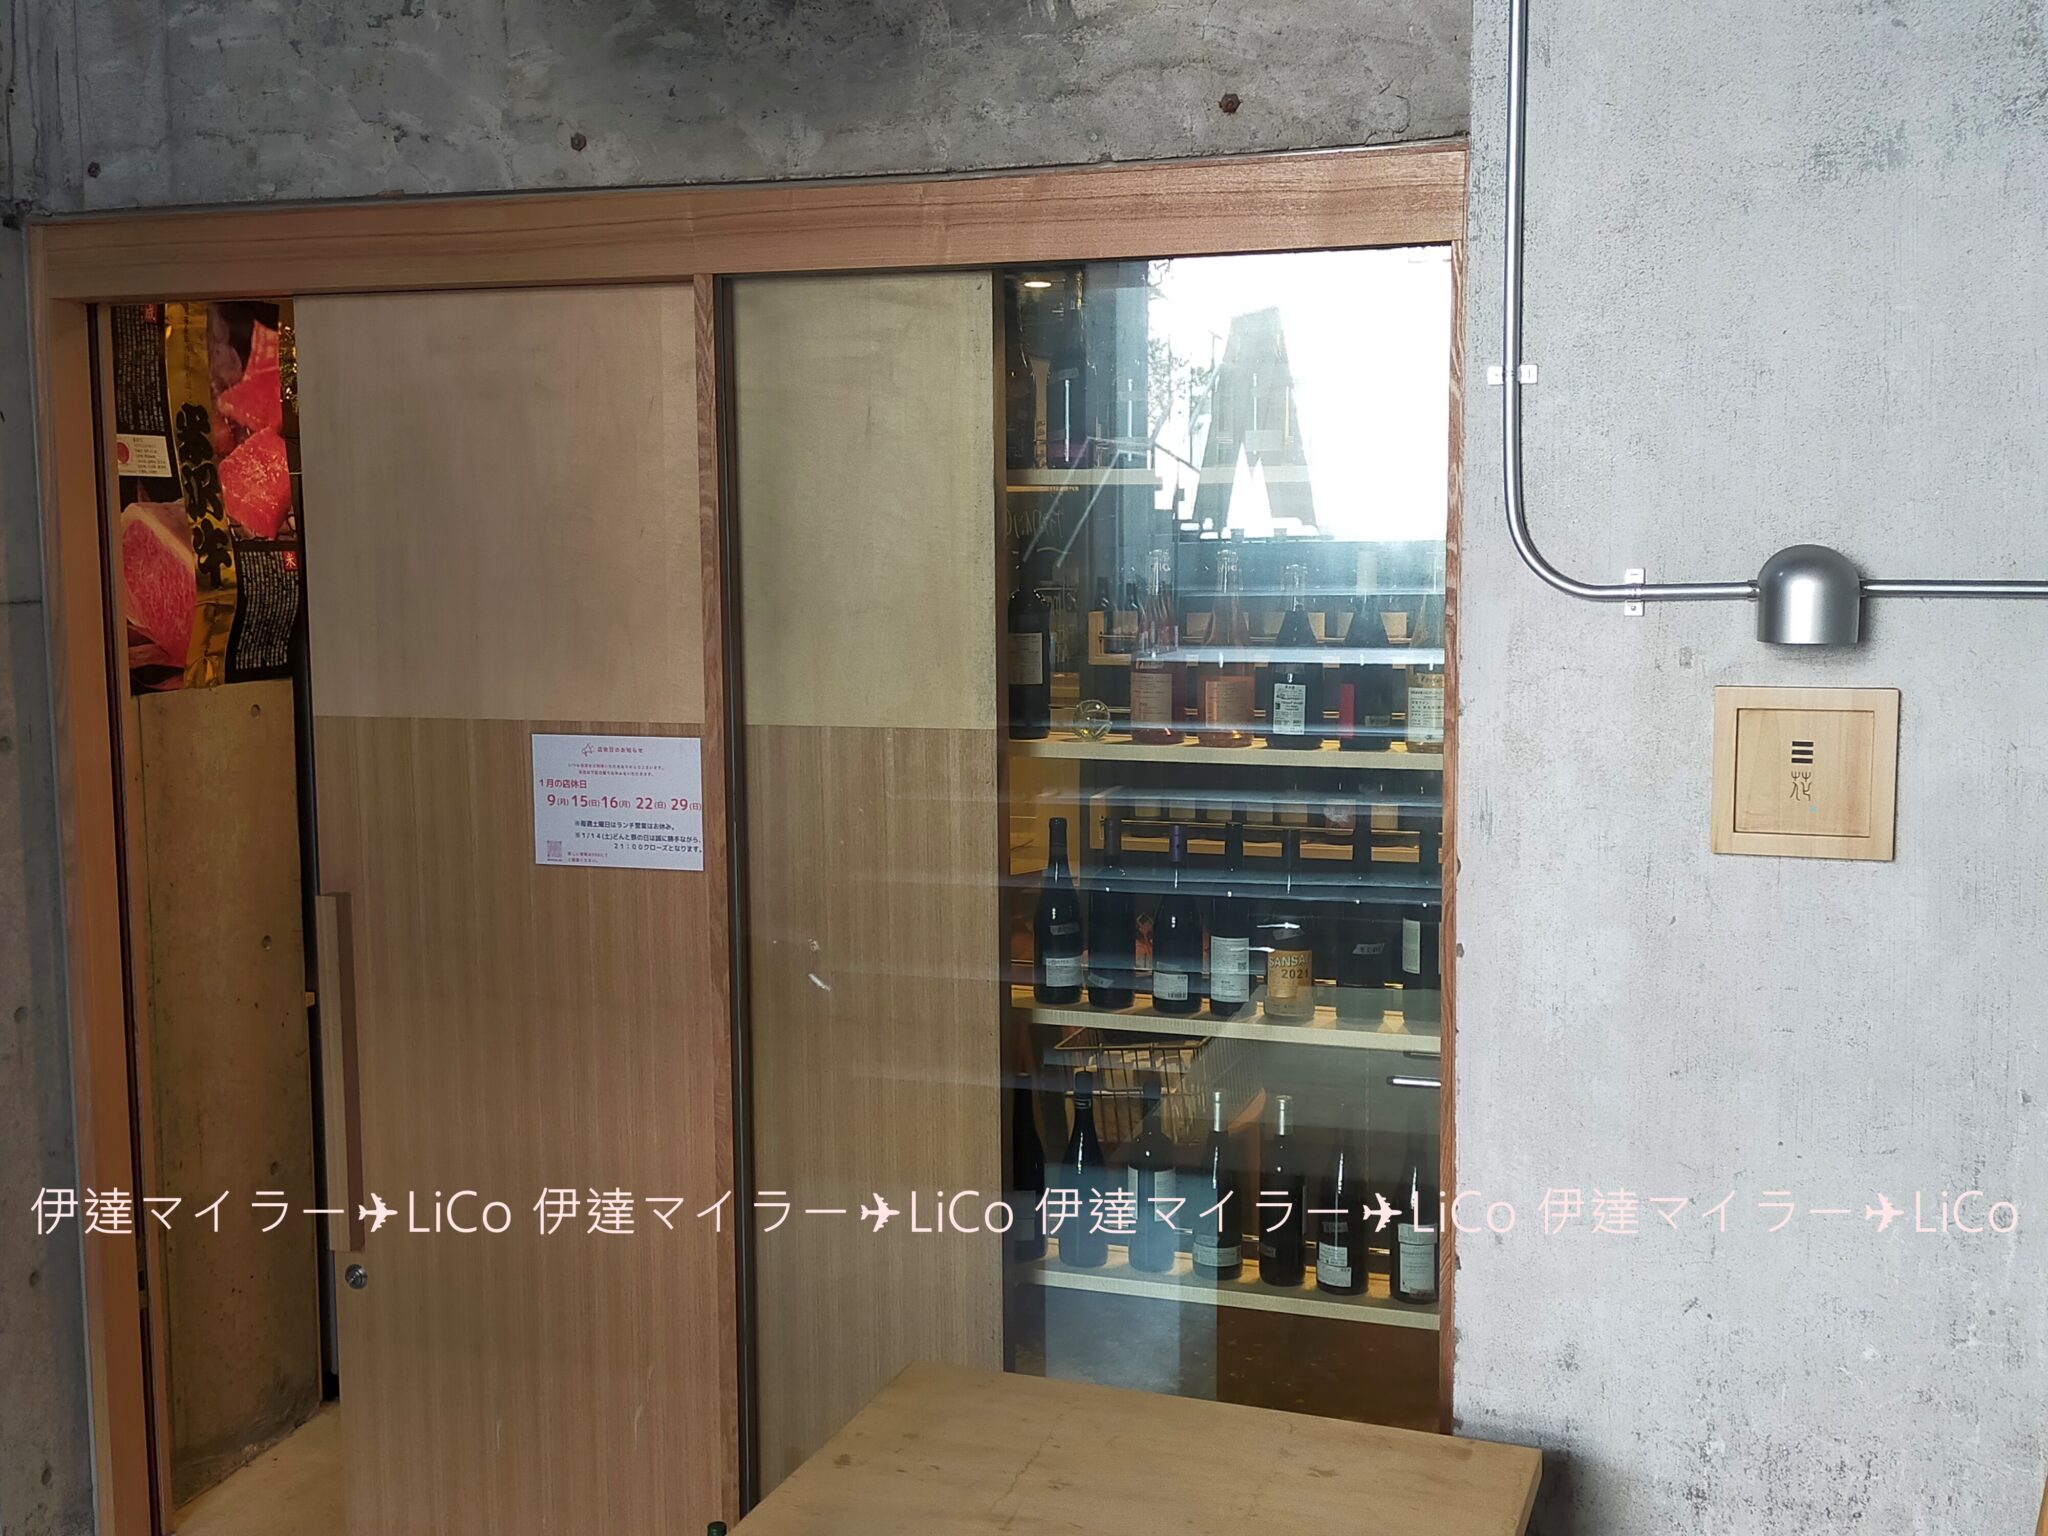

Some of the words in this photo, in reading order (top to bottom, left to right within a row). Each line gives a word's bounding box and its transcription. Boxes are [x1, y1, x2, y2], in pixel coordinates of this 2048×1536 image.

[539, 779, 587, 789] 1月の店休日
[1281, 968, 1310, 979] 2021
